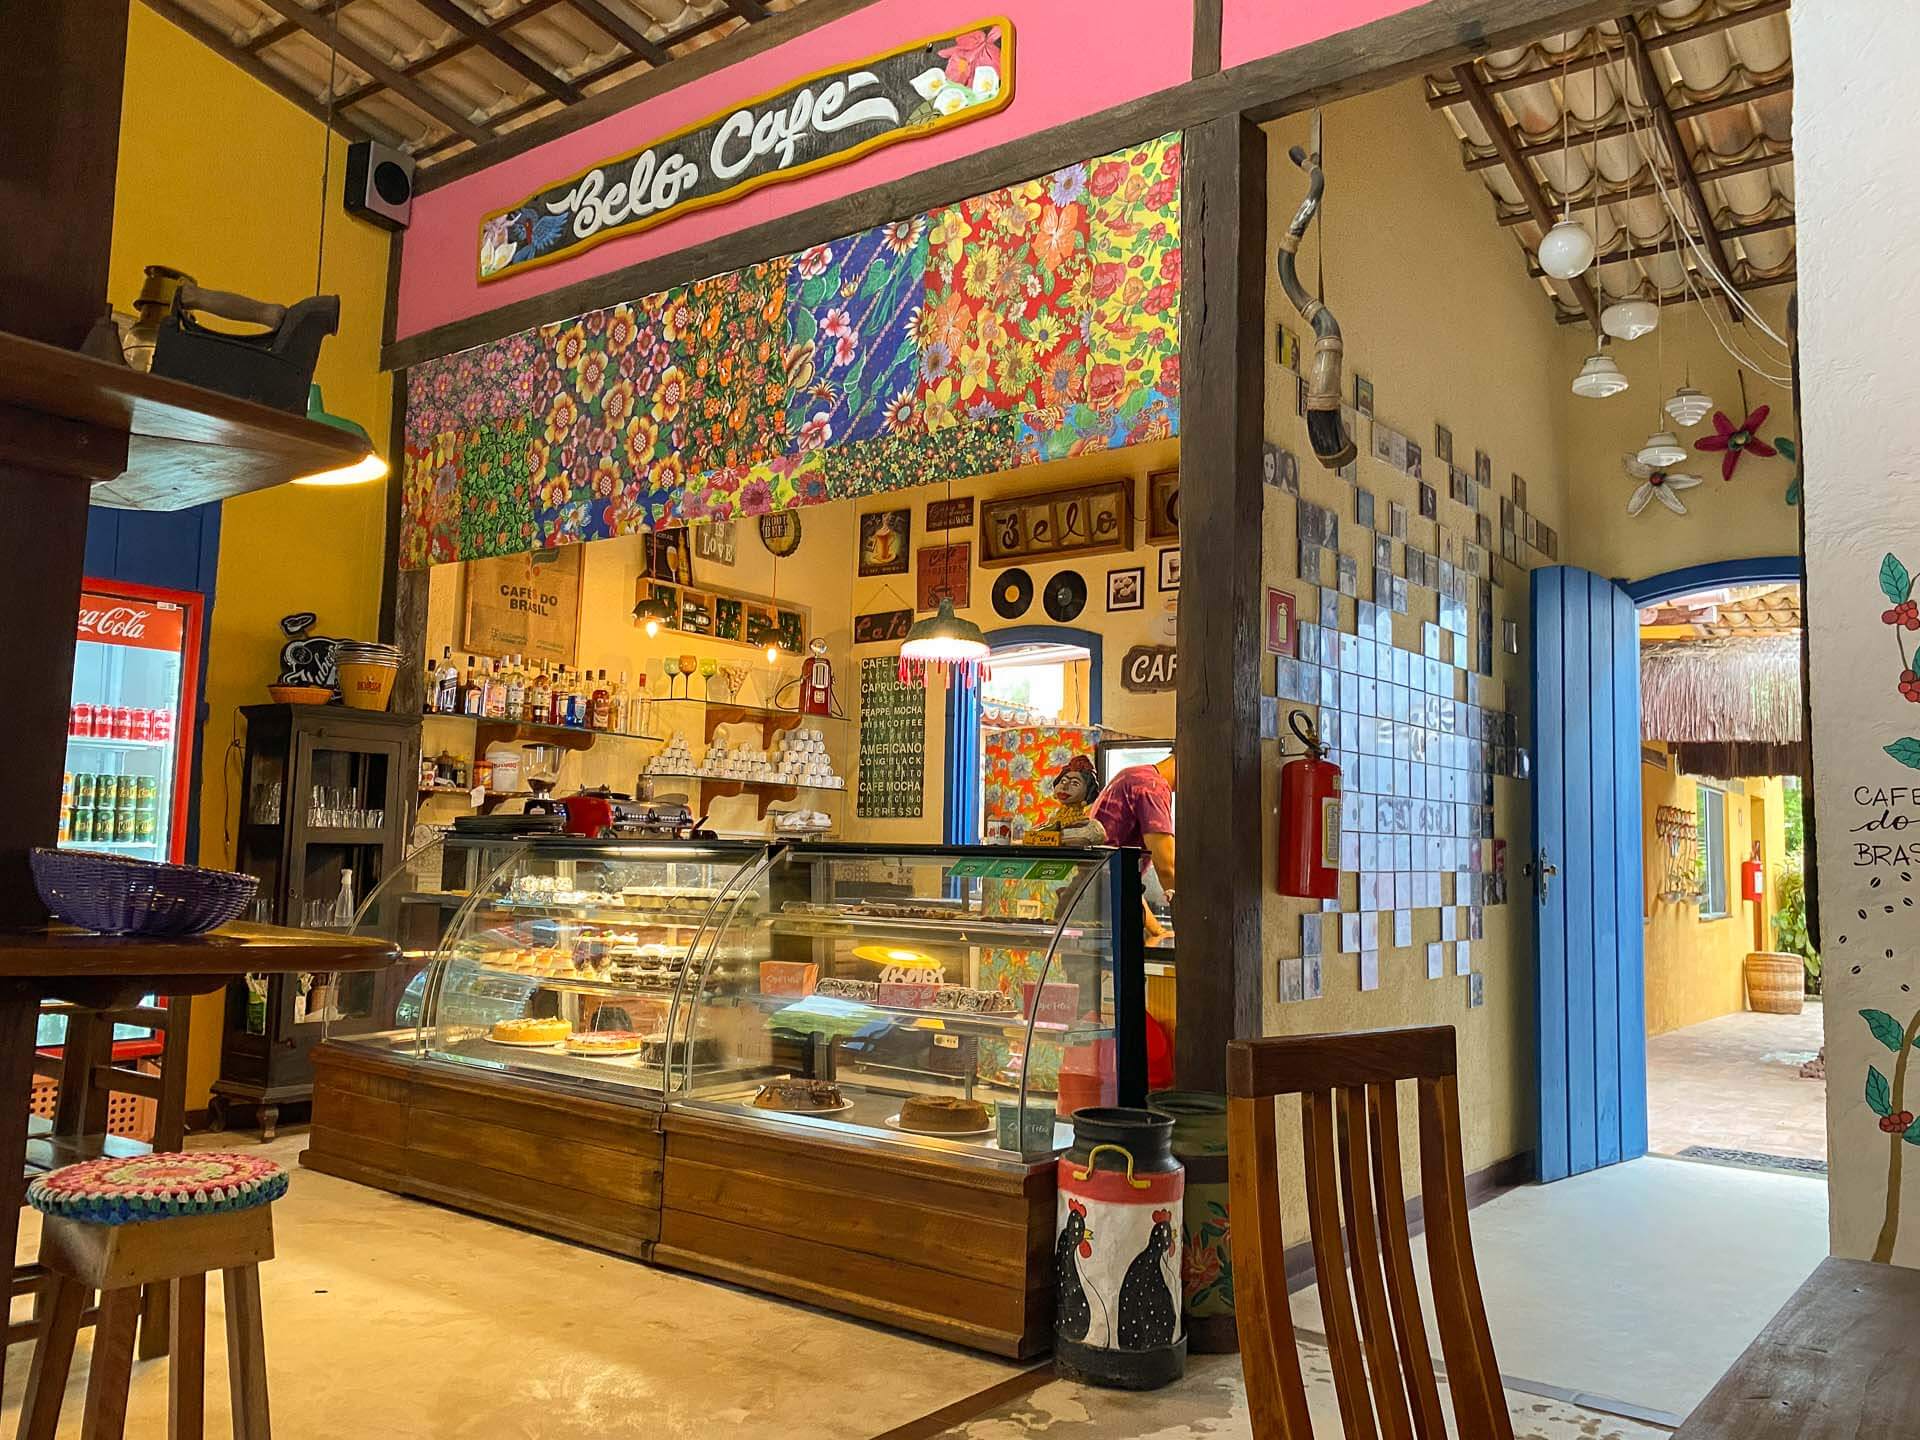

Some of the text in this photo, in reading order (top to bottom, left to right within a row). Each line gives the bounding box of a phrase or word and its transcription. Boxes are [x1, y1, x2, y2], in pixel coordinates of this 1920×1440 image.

[715, 523, 724, 536] IS
[703, 533, 732, 563] LOVE
[540, 593, 558, 607] DO
[510, 598, 548, 617] BRASIL
[862, 657, 888, 669] CAFE
[861, 679, 923, 693] CAPPUCCINO
[893, 705, 922, 715] MOCHA
[887, 718, 923, 728] COFFEE
[860, 742, 922, 755] AMERICANO
[860, 756, 922, 766] LONG BLACK
[859, 781, 921, 792] CAFE MOCHA
[858, 806, 921, 818] ESPRESSO
[1849, 809, 1920, 832] do
